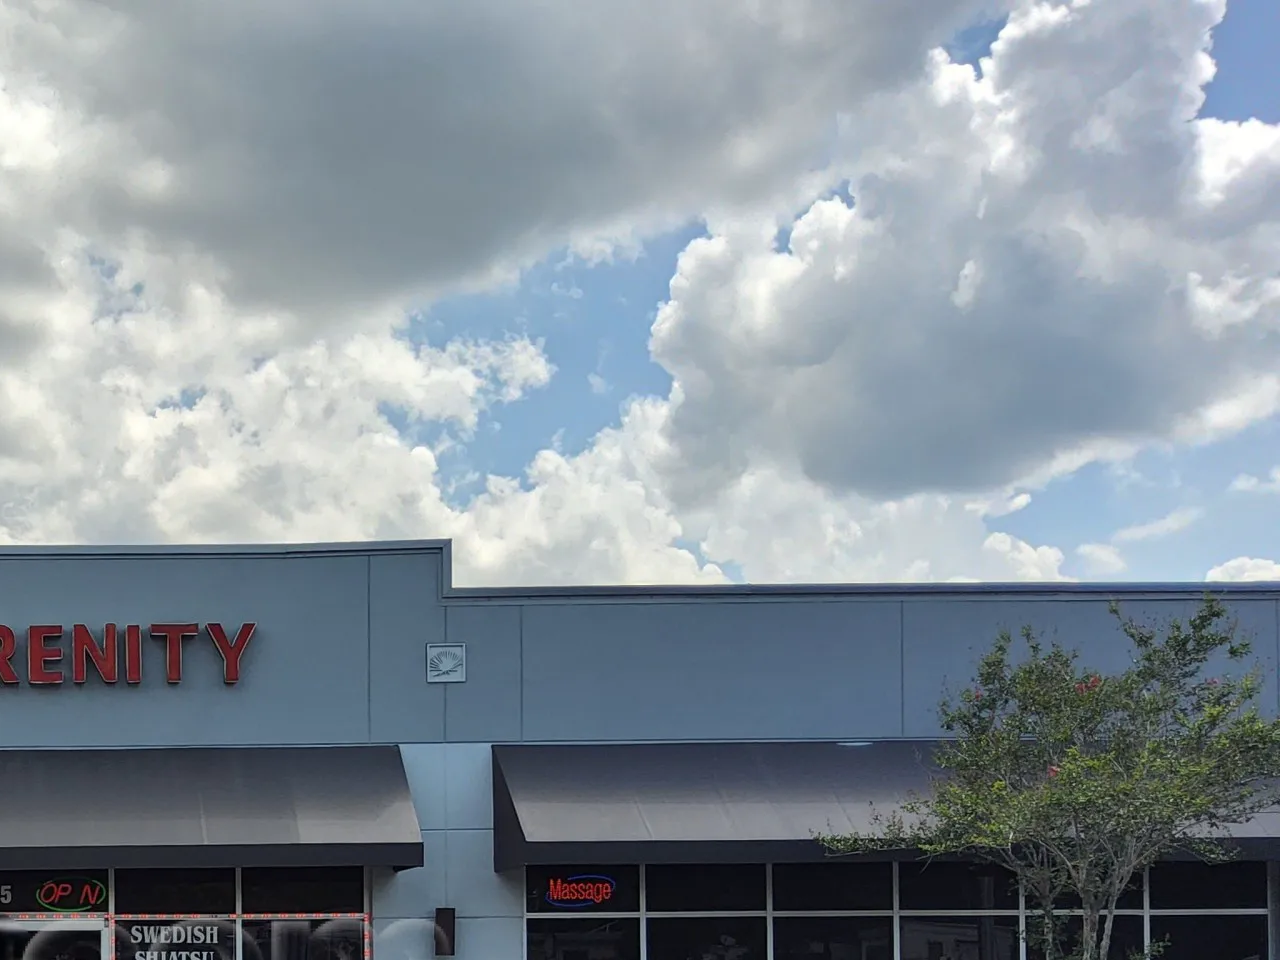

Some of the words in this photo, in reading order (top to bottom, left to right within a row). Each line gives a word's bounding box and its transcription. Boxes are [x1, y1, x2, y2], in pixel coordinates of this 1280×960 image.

[40, 883, 100, 905] OPN
[549, 879, 612, 904] Massage
[130, 926, 219, 944] SWEDISH
